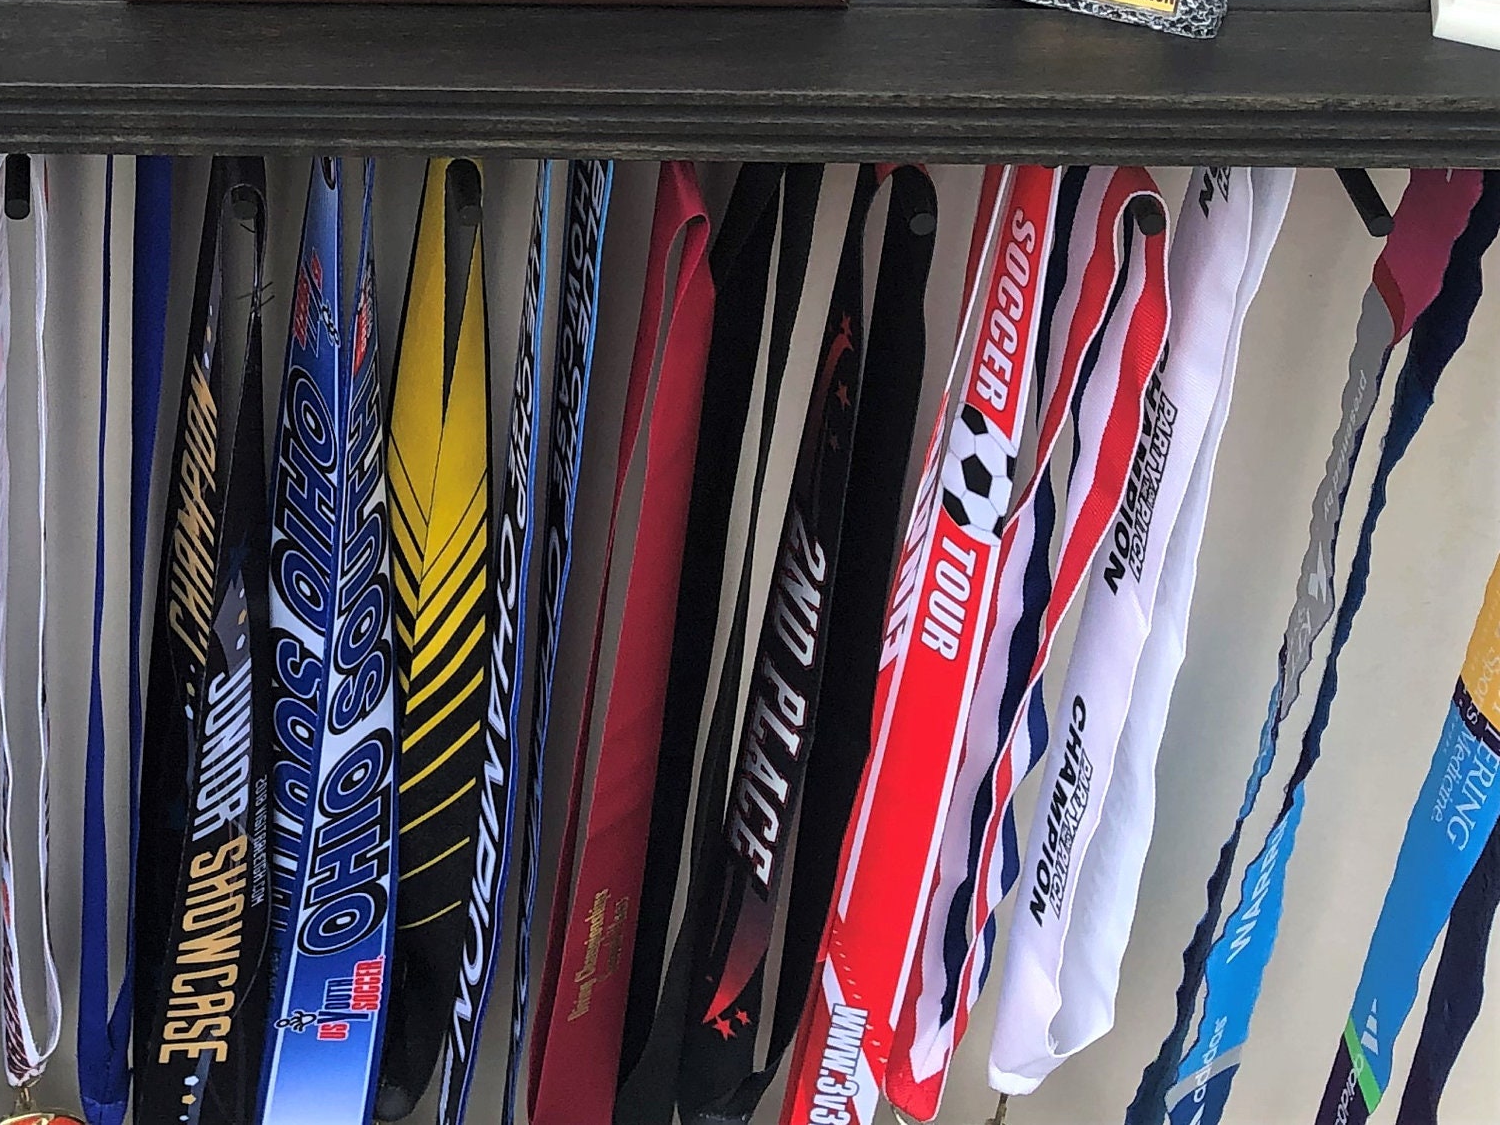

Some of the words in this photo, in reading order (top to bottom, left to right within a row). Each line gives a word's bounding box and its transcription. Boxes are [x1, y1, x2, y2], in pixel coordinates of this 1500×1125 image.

[554, 161, 590, 498] HOWCASE
[975, 208, 1037, 413] SOCCER
[275, 365, 338, 635] OHIO
[1148, 391, 1178, 477] PARTY
[329, 359, 393, 736] SOUTH
[776, 508, 827, 669] 2ND
[920, 535, 978, 661] TOUR
[1128, 499, 1153, 584] PITCH
[192, 659, 251, 841] JUNIOR
[730, 651, 809, 888] PLACE
[1029, 695, 1087, 927] CHAMPION
[1064, 747, 1094, 829] PARTY
[297, 730, 393, 956] OHIO
[1050, 840, 1076, 920] PITCH
[158, 834, 248, 1064] SHOWCASE
[317, 978, 373, 1022] YOUTH
[351, 957, 386, 1012] SOCCER
[317, 1022, 350, 1041] US
[807, 1003, 869, 1125] www.3v3
[1192, 1015, 1228, 1103] adidas
